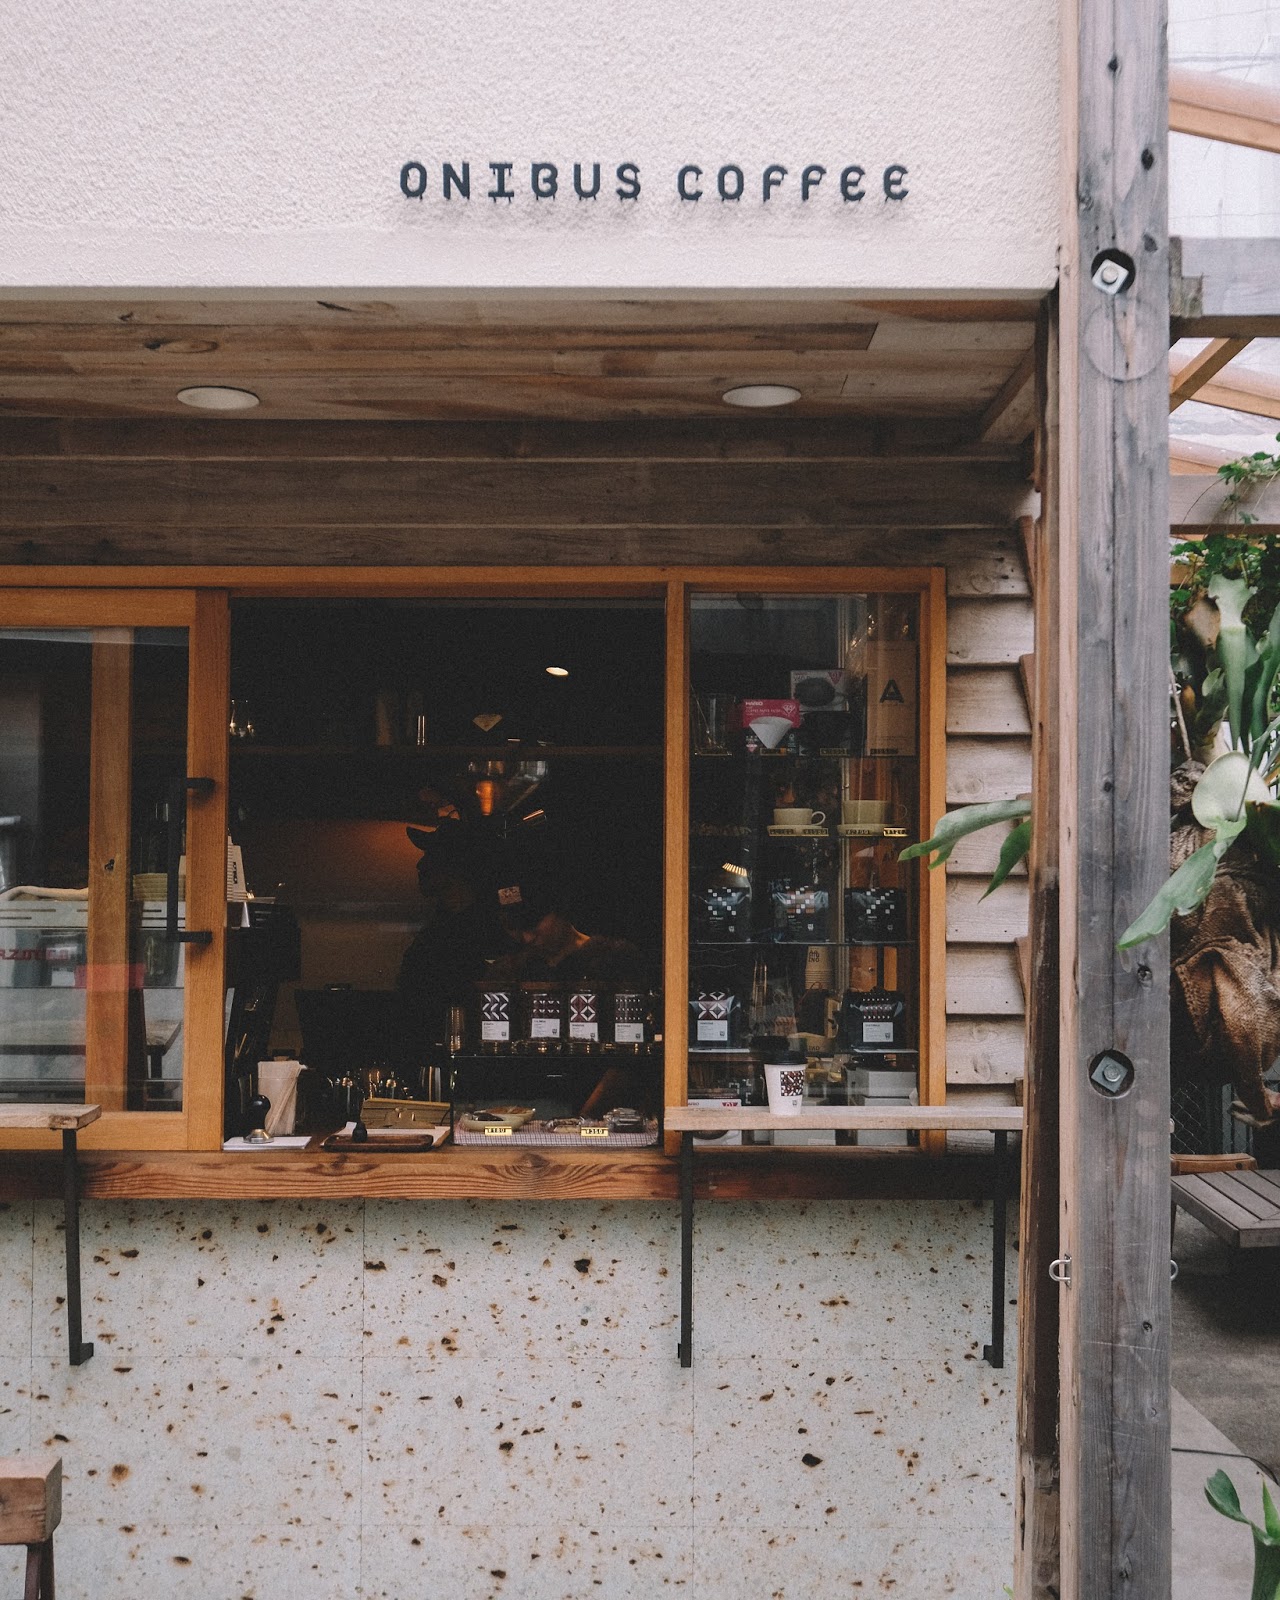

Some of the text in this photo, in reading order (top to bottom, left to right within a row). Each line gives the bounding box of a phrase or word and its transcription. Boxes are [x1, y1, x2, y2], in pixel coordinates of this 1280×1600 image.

[399, 160, 910, 200] ONIBUS COFFEE
[880, 679, 904, 703] A
